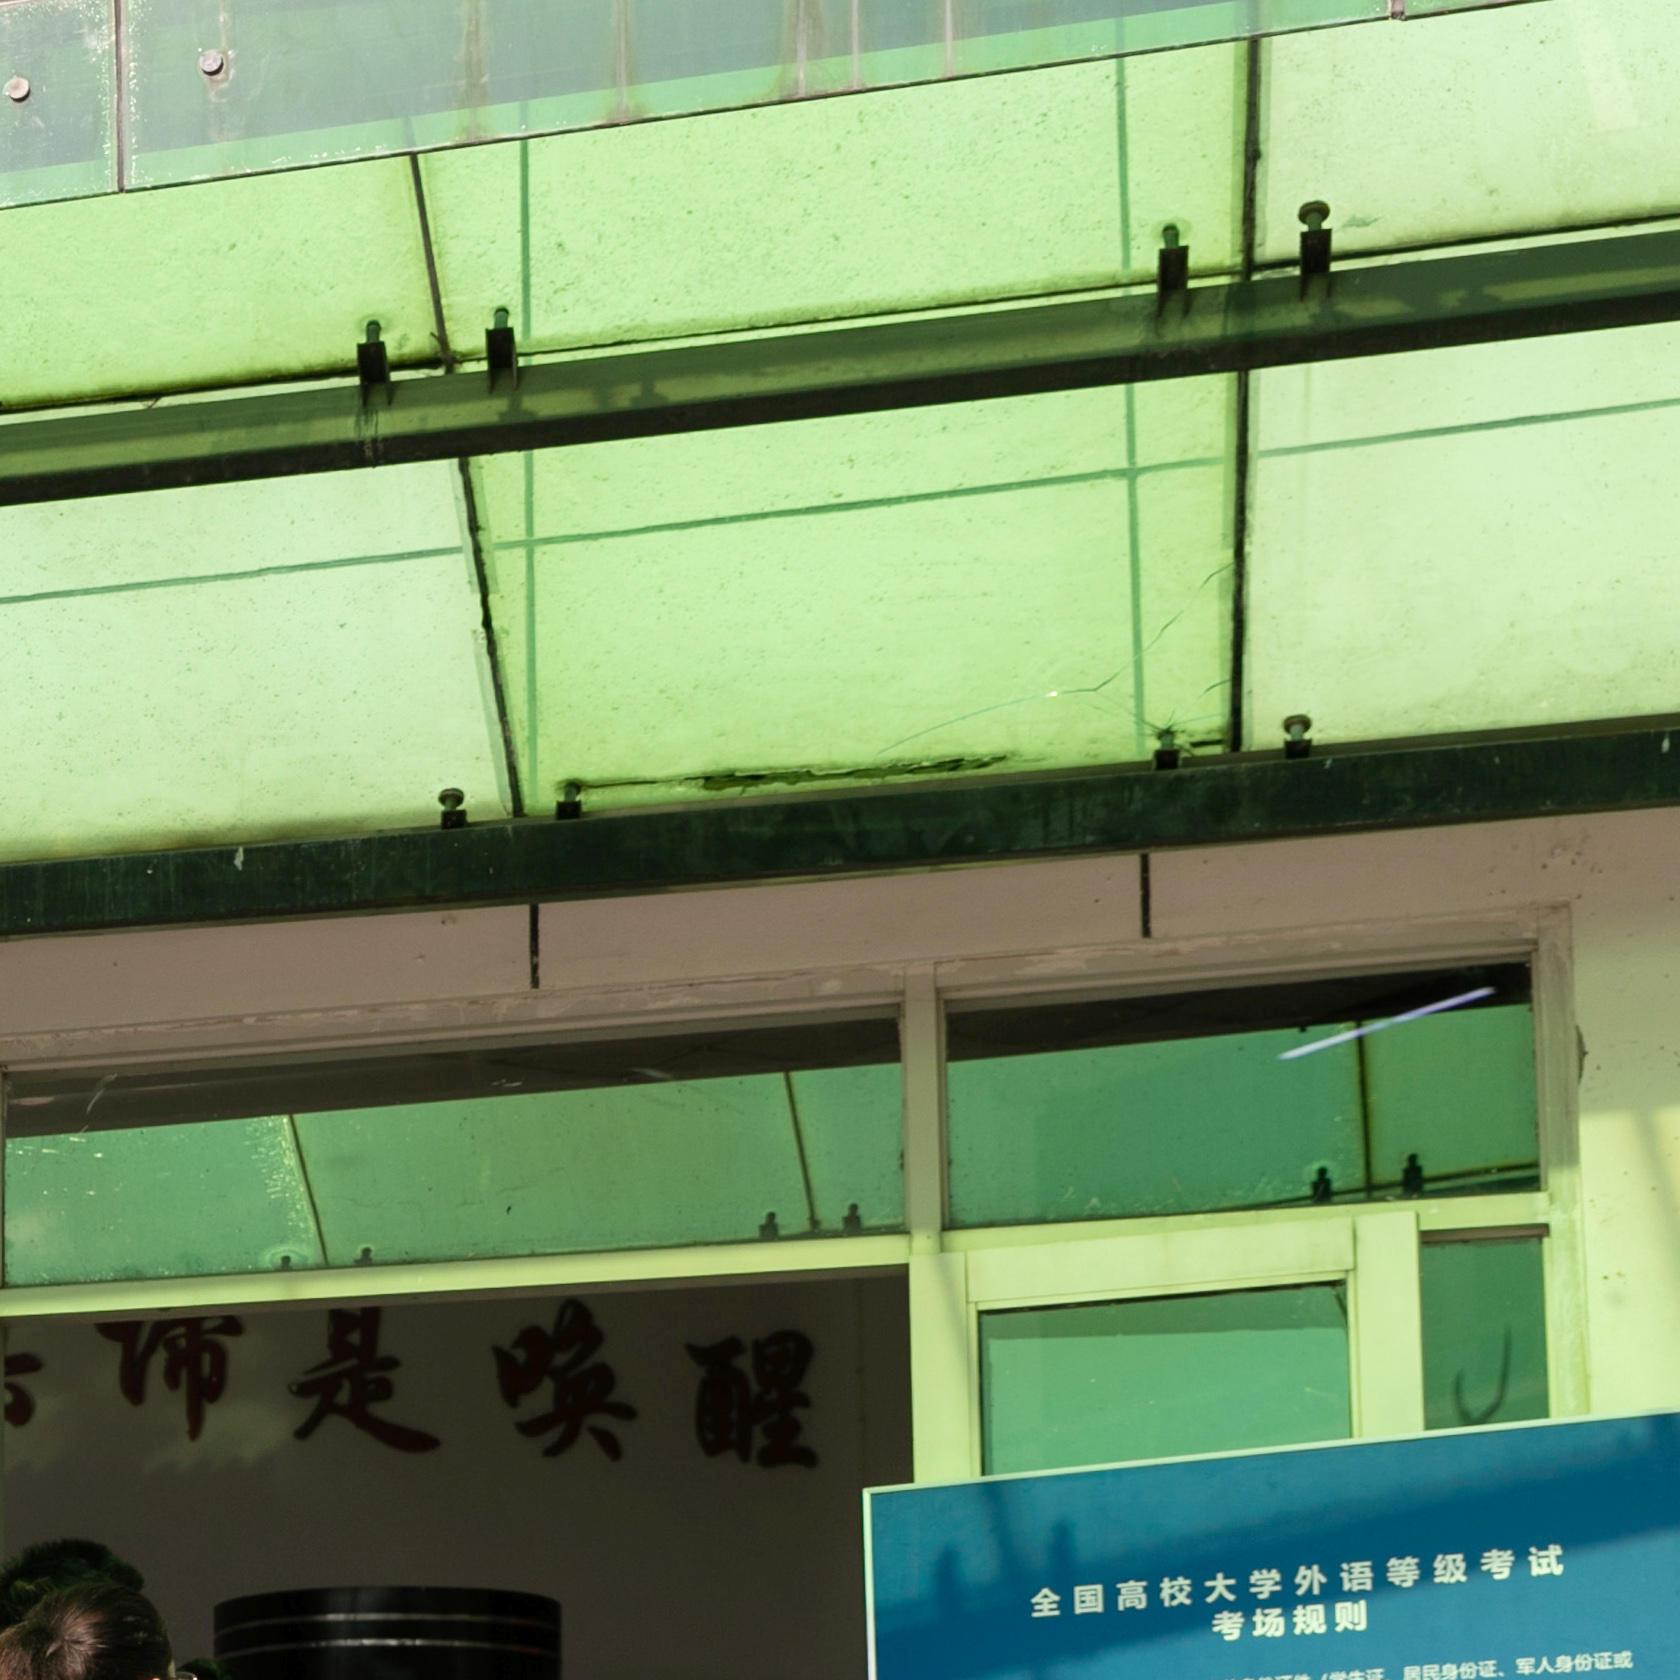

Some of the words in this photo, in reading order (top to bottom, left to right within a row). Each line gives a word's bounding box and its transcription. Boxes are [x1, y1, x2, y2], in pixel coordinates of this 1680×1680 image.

[1029, 1544, 1566, 1619] 全国高校大学外语等级考试
[1211, 1600, 1369, 1642] 考场规则
